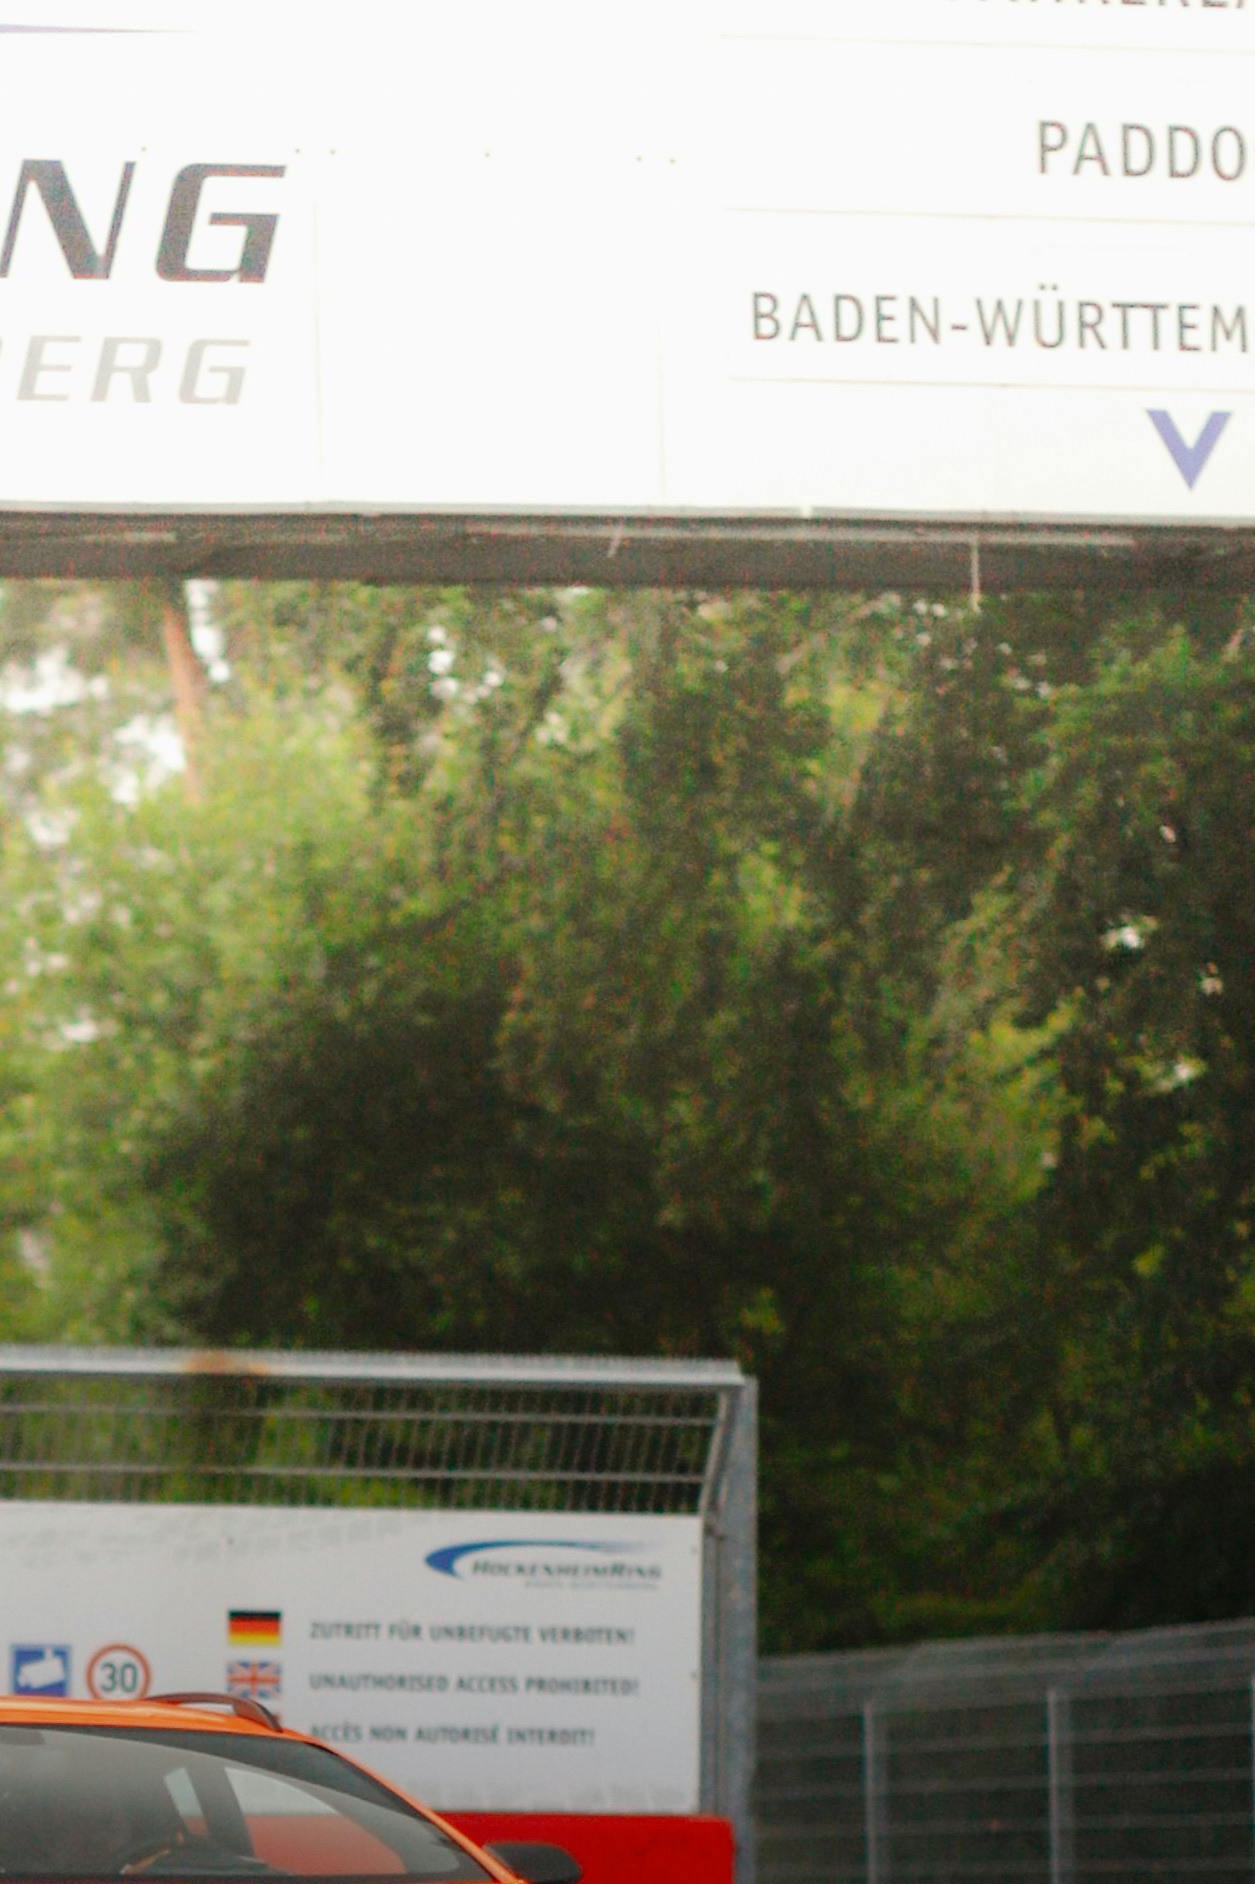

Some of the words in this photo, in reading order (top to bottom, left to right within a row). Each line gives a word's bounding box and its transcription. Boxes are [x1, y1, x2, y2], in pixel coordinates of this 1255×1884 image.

[1038, 119, 1248, 182] PADDO
[752, 282, 1249, 354] BADEN-WÜRTTEM
[310, 1621, 380, 1640] ZUTRITT
[388, 1618, 422, 1641] FÜR
[429, 1624, 531, 1644] UNBEFUGTE
[538, 1625, 634, 1645] VERBOTEN!
[100, 1661, 137, 1693] 30
[309, 1673, 448, 1692] UNAUTHORISED
[457, 1674, 518, 1694] ACCESS
[525, 1676, 640, 1696] PROHIBITED!
[369, 1725, 407, 1742] NON
[415, 1721, 499, 1745] AUTORISÉ
[507, 1727, 595, 1747] INTERDIT!
